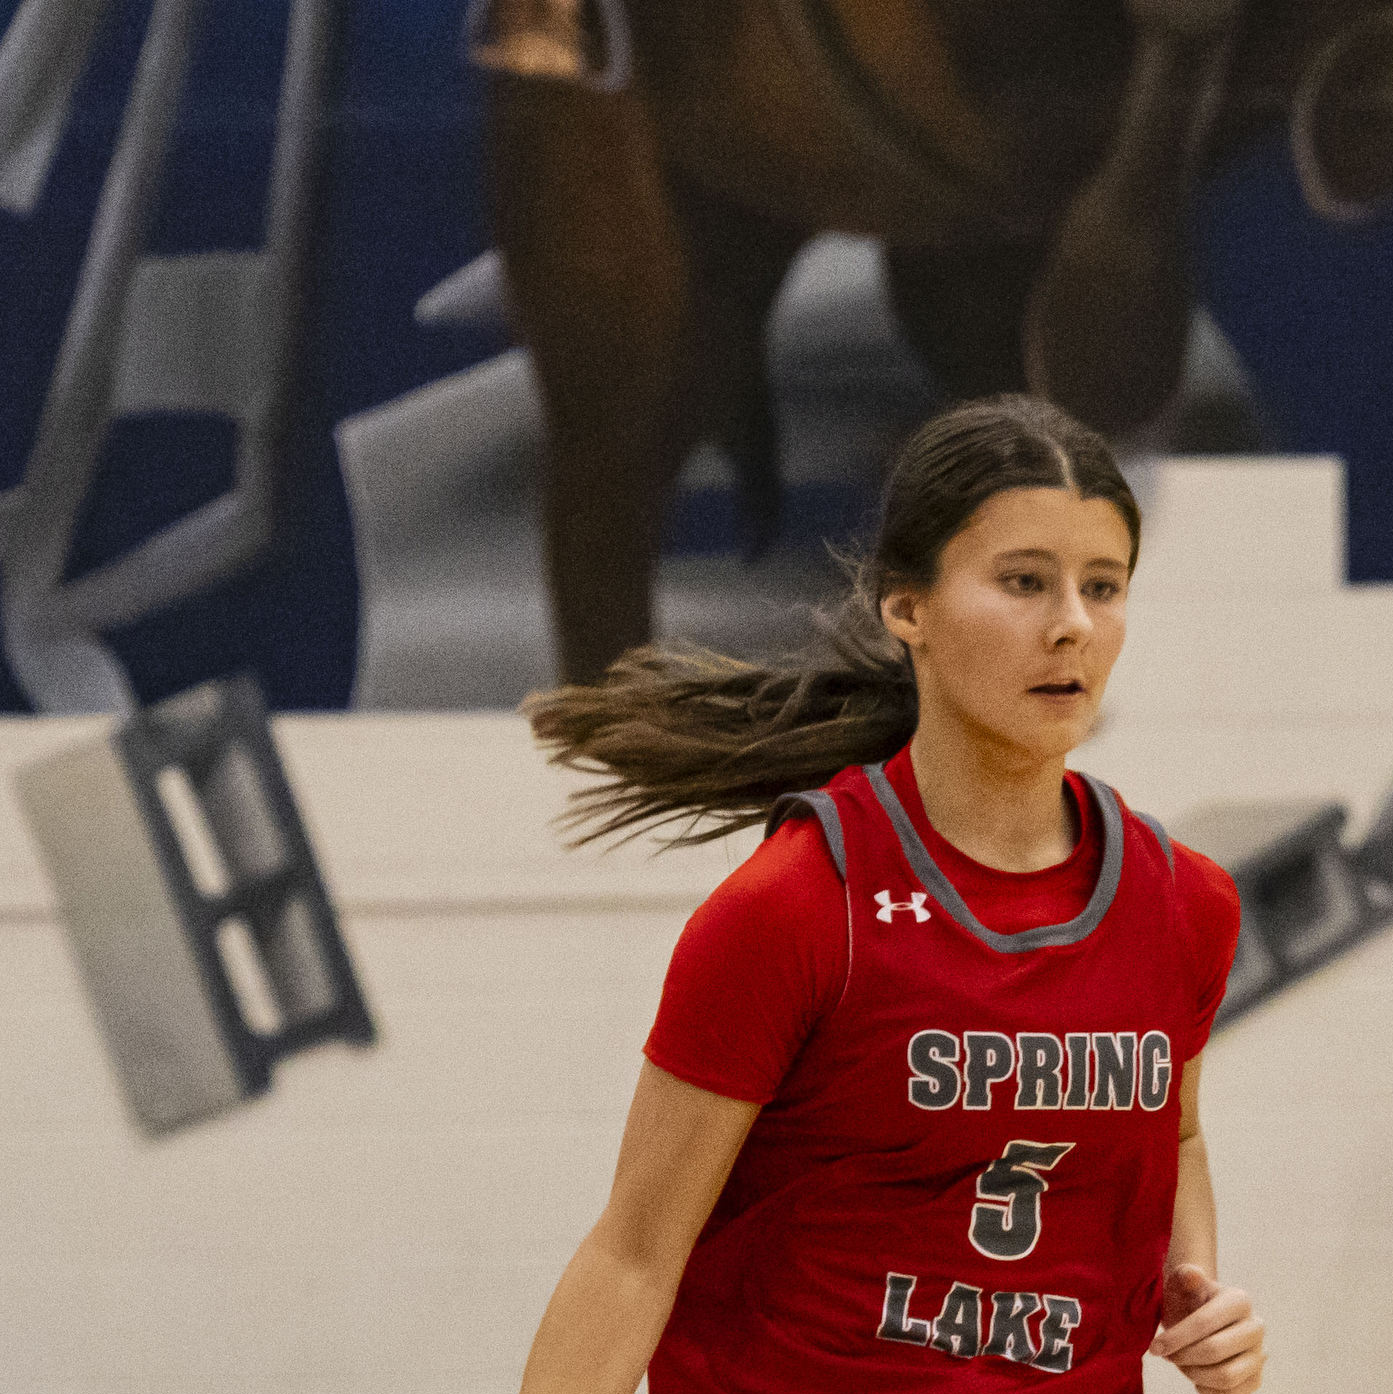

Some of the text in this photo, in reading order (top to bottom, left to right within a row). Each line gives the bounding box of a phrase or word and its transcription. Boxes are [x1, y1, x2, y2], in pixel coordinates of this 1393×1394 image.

[907, 1029, 1172, 1111] SPRING
[967, 1139, 1077, 1261] 5
[875, 1271, 1082, 1373] LAKE
